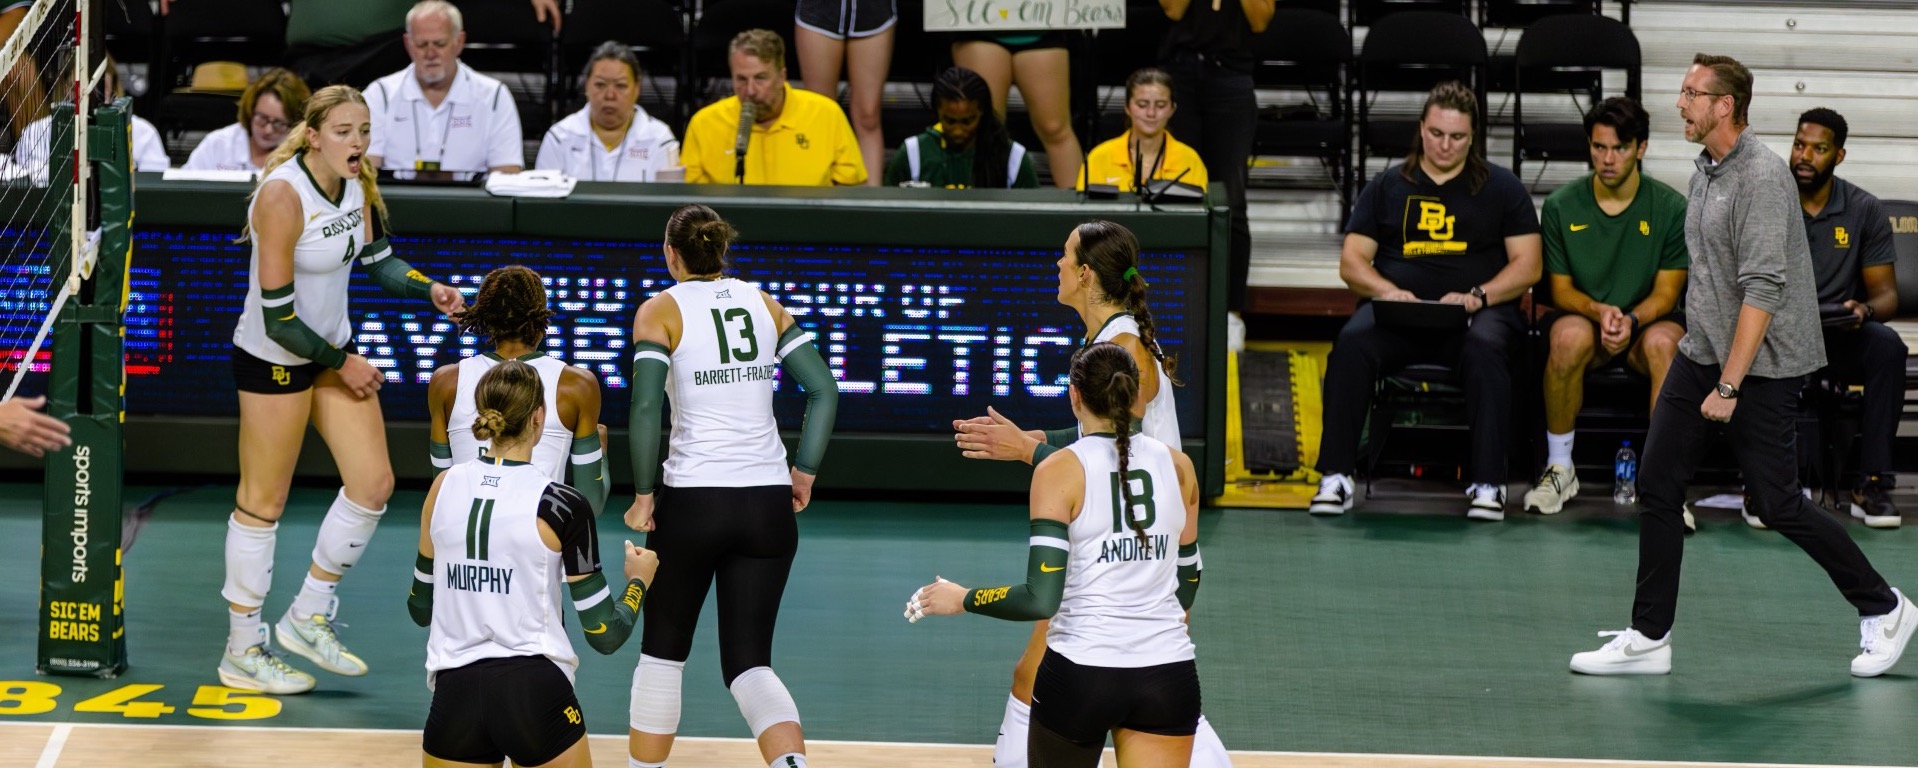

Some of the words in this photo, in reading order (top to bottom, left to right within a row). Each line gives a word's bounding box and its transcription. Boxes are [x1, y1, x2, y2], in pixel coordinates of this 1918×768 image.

[1064, 0, 1123, 26] Bears
[1417, 201, 1456, 241] BU
[342, 234, 355, 266] 4
[710, 307, 759, 365] 13
[271, 365, 291, 385] BU
[72, 445, 91, 507] sports
[1109, 468, 1156, 534] 18
[71, 508, 88, 583] imports
[465, 497, 496, 562] 11
[1097, 534, 1169, 564] ANDREW
[446, 562, 513, 595] MURPHY
[50, 622, 100, 642] BEARS
